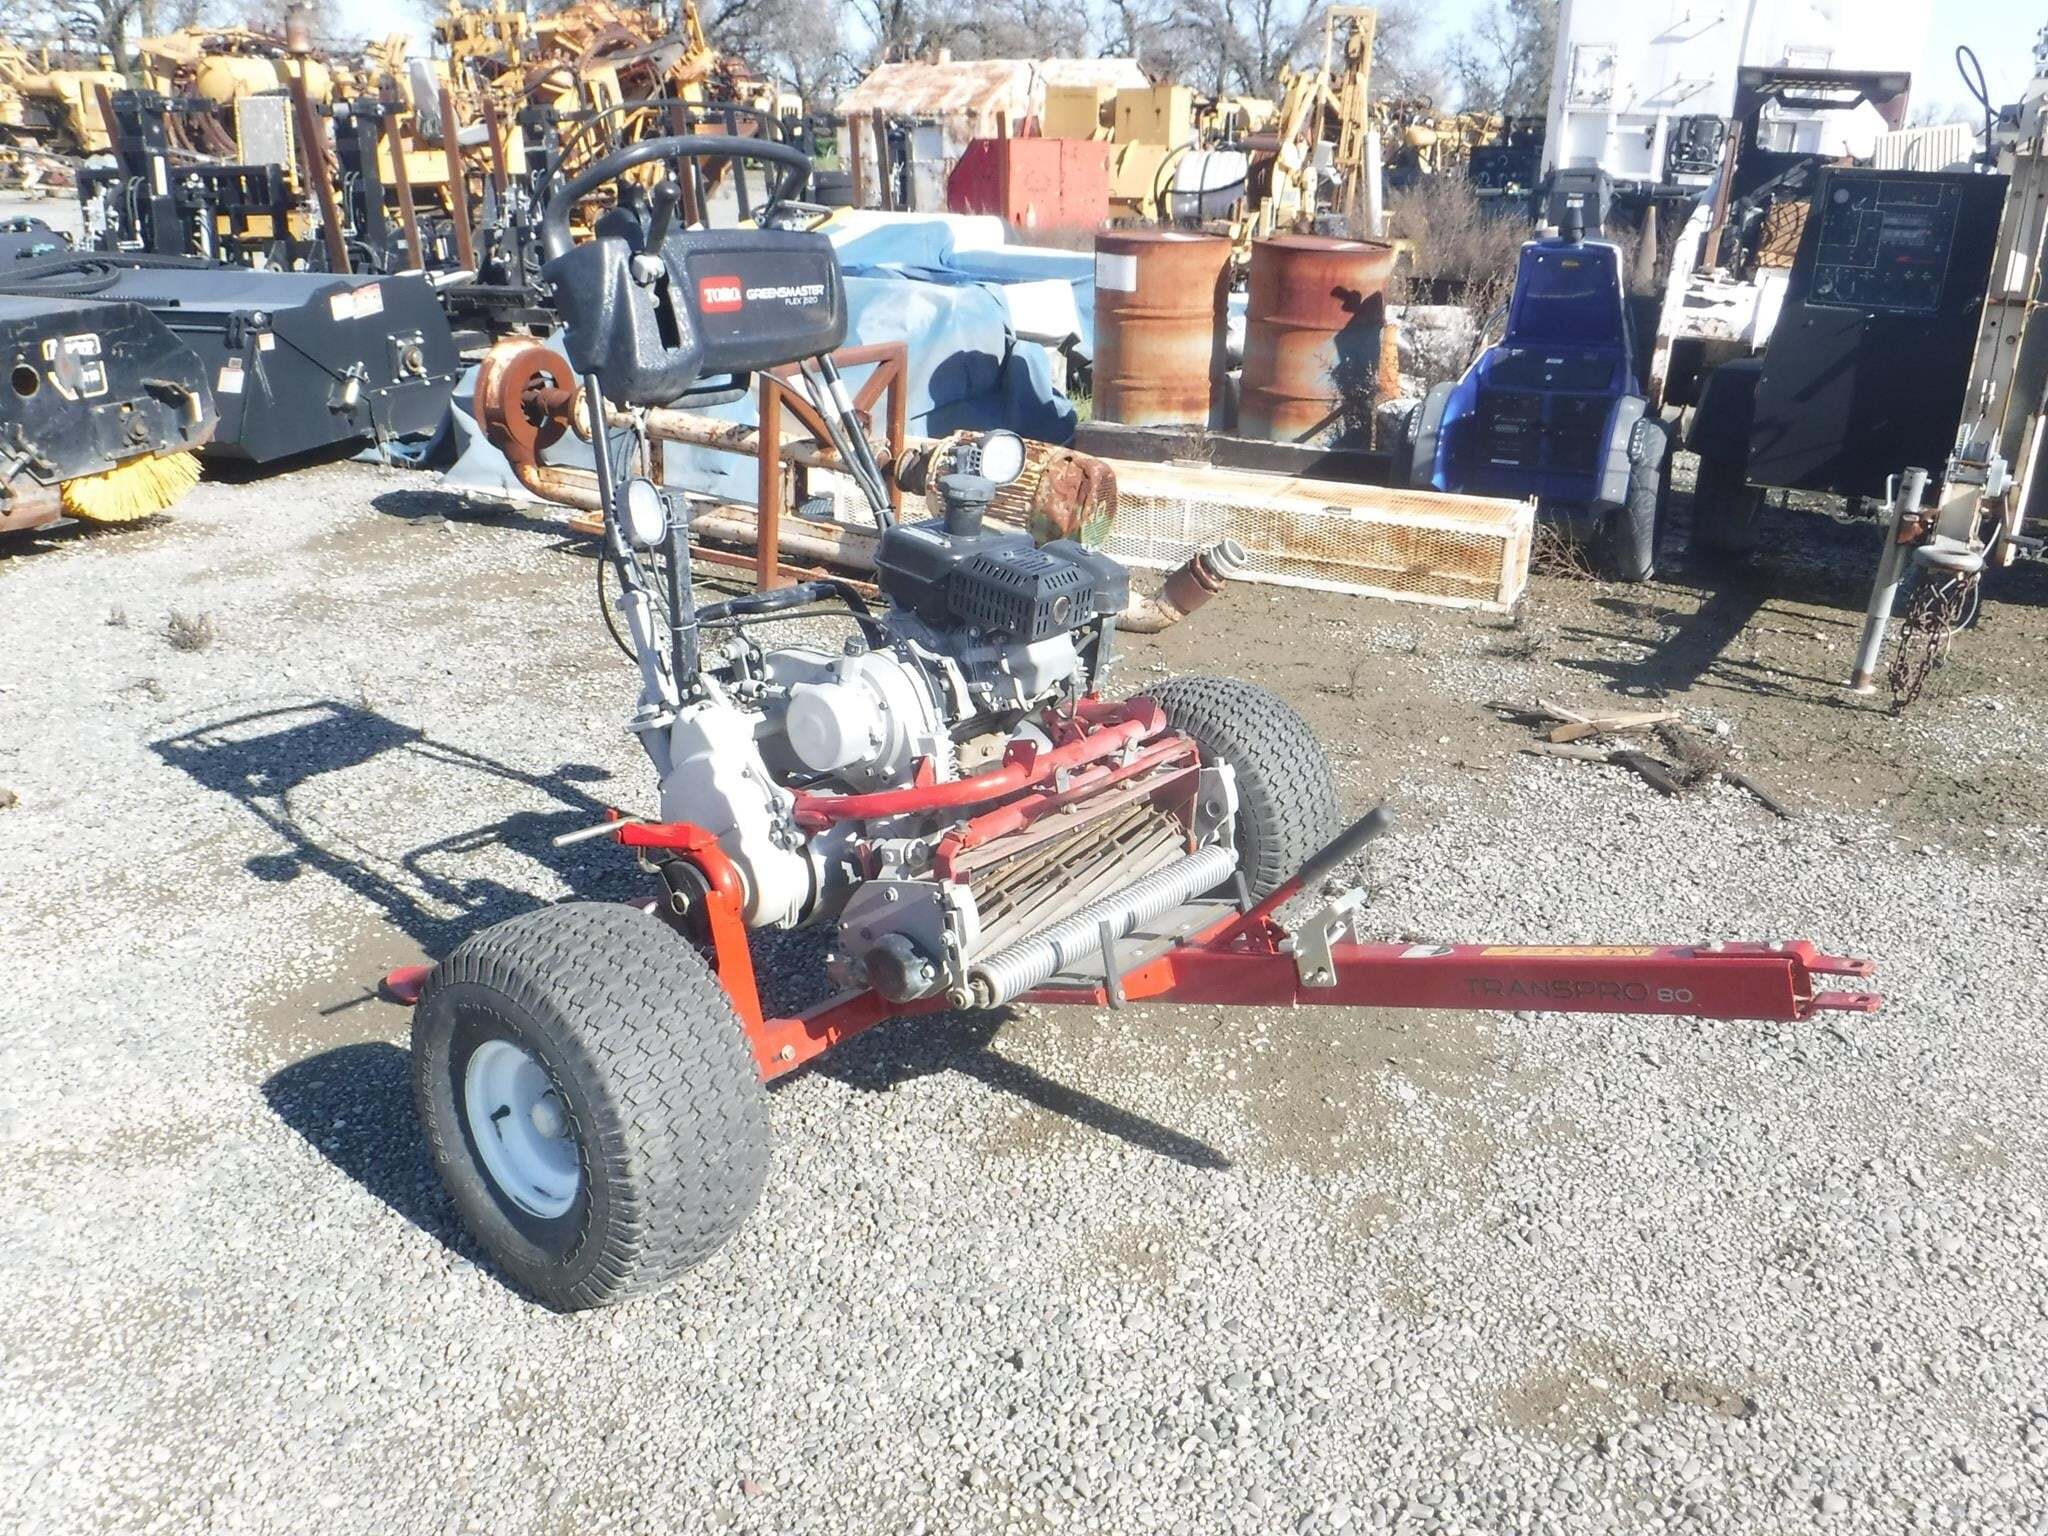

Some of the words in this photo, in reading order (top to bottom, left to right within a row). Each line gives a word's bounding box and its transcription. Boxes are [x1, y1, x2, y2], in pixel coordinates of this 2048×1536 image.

[704, 287, 741, 304] TORO
[746, 285, 824, 300] GREENSMASTER
[785, 297, 801, 306] FLEX
[1466, 977, 1649, 1001] TRANSPRO
[1656, 988, 1694, 1003] 80
